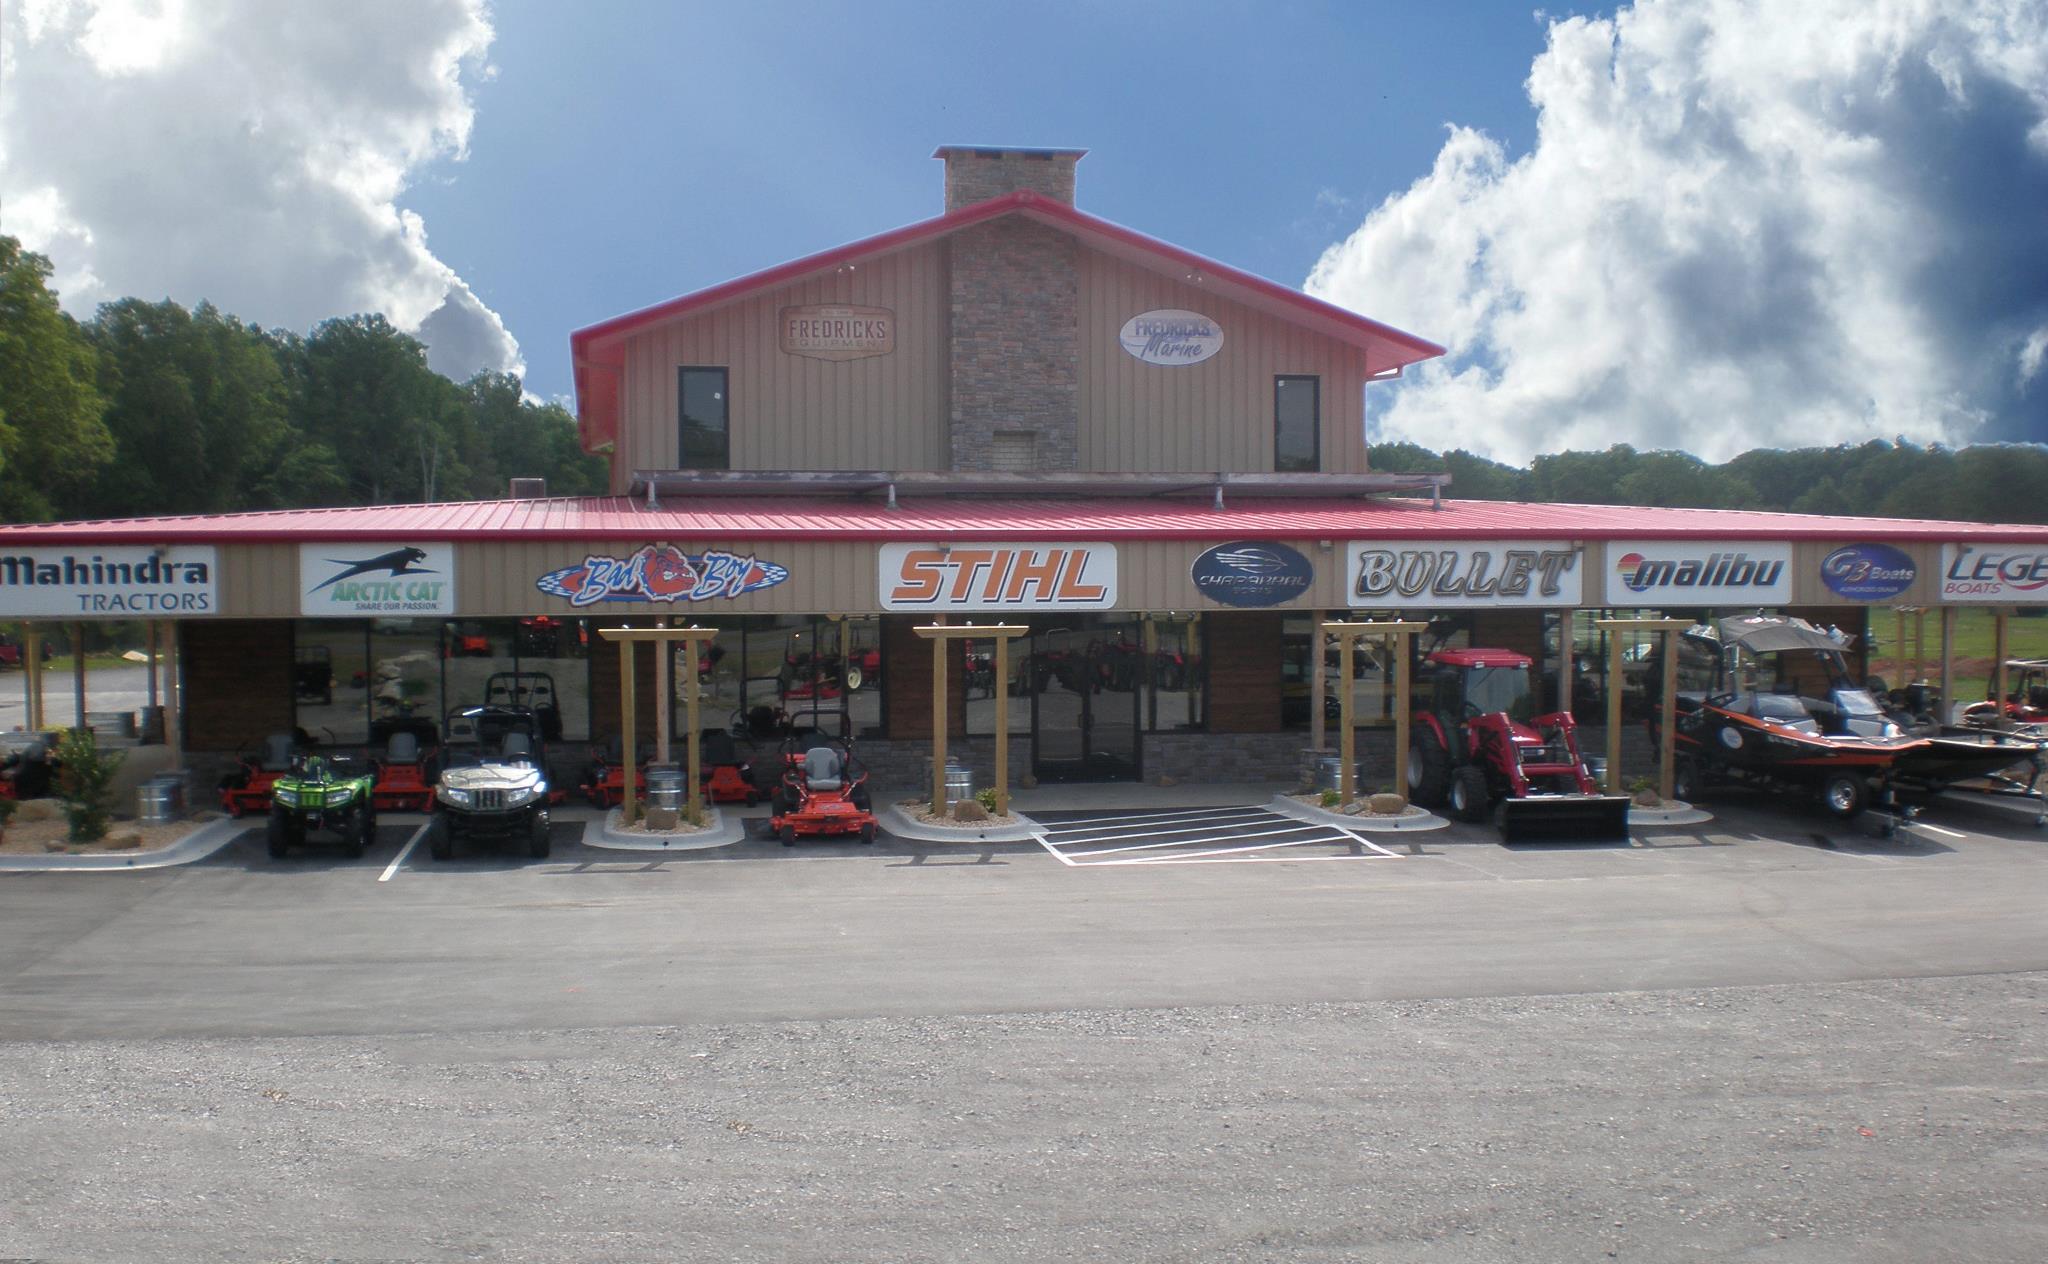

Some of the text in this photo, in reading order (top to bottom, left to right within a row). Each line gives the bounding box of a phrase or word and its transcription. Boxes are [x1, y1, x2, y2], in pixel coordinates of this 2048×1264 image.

[789, 320, 886, 339] FREDRICKS
[1140, 335, 1203, 357] Marine
[0, 555, 208, 585] Mahindra
[570, 552, 754, 606] Bad Boy
[891, 550, 1108, 603] STIHL
[1356, 550, 1576, 596] BULLET
[1632, 552, 1785, 587] malibu
[1870, 566, 1915, 580] Boats
[330, 581, 443, 601] ARCTIC CAT
[1945, 583, 2002, 594] BOATS
[77, 593, 209, 611] TRACTORS
[355, 602, 381, 610] SHARE
[383, 602, 400, 610] OUR
